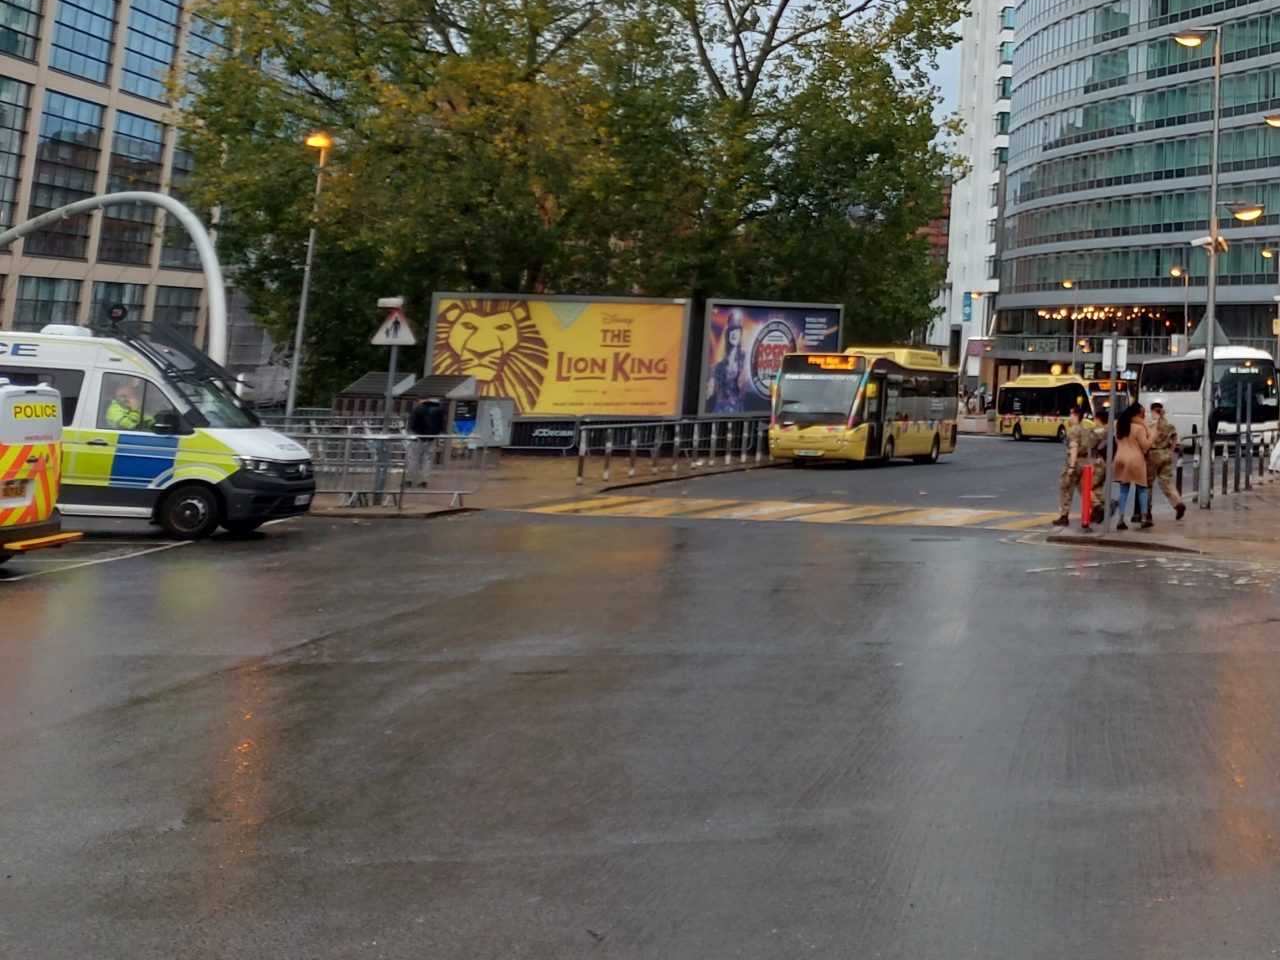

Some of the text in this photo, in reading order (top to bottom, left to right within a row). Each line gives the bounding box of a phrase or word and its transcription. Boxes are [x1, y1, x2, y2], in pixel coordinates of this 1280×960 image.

[600, 312, 635, 327] Disney
[601, 329, 631, 343] THE
[556, 351, 667, 382] LION KING
[847, 356, 857, 370] 2
[13, 404, 57, 420] POLICE
[531, 428, 574, 437] JCDecaux
